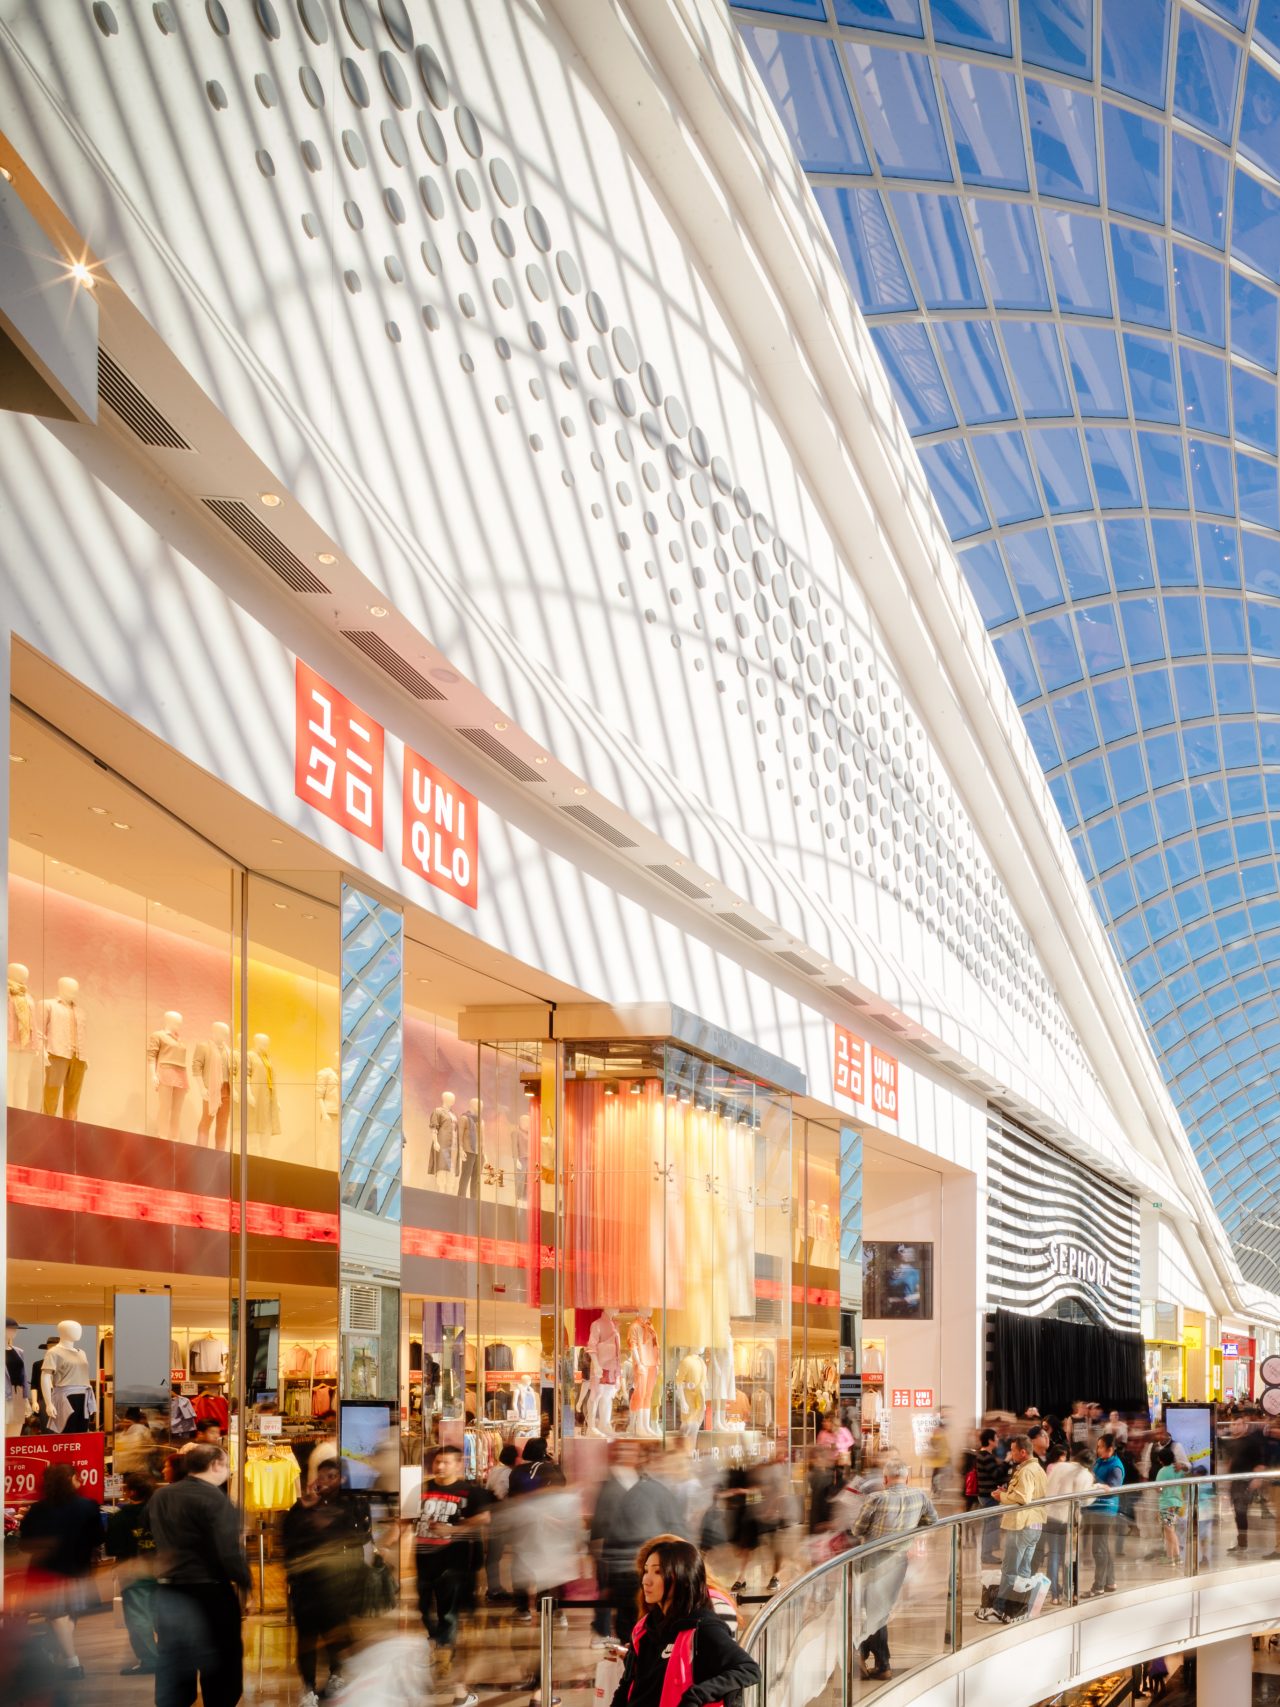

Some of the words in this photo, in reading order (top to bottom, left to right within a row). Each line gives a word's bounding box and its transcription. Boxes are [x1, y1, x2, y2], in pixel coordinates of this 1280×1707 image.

[412, 767, 465, 841] UNI
[411, 820, 470, 887] QLO
[873, 1056, 895, 1087] UNI
[874, 1082, 896, 1112] QLO
[1050, 1241, 1111, 1287] SEPHORA
[10, 1445, 48, 1455] SPECIAL
[52, 1443, 81, 1452] OFFER
